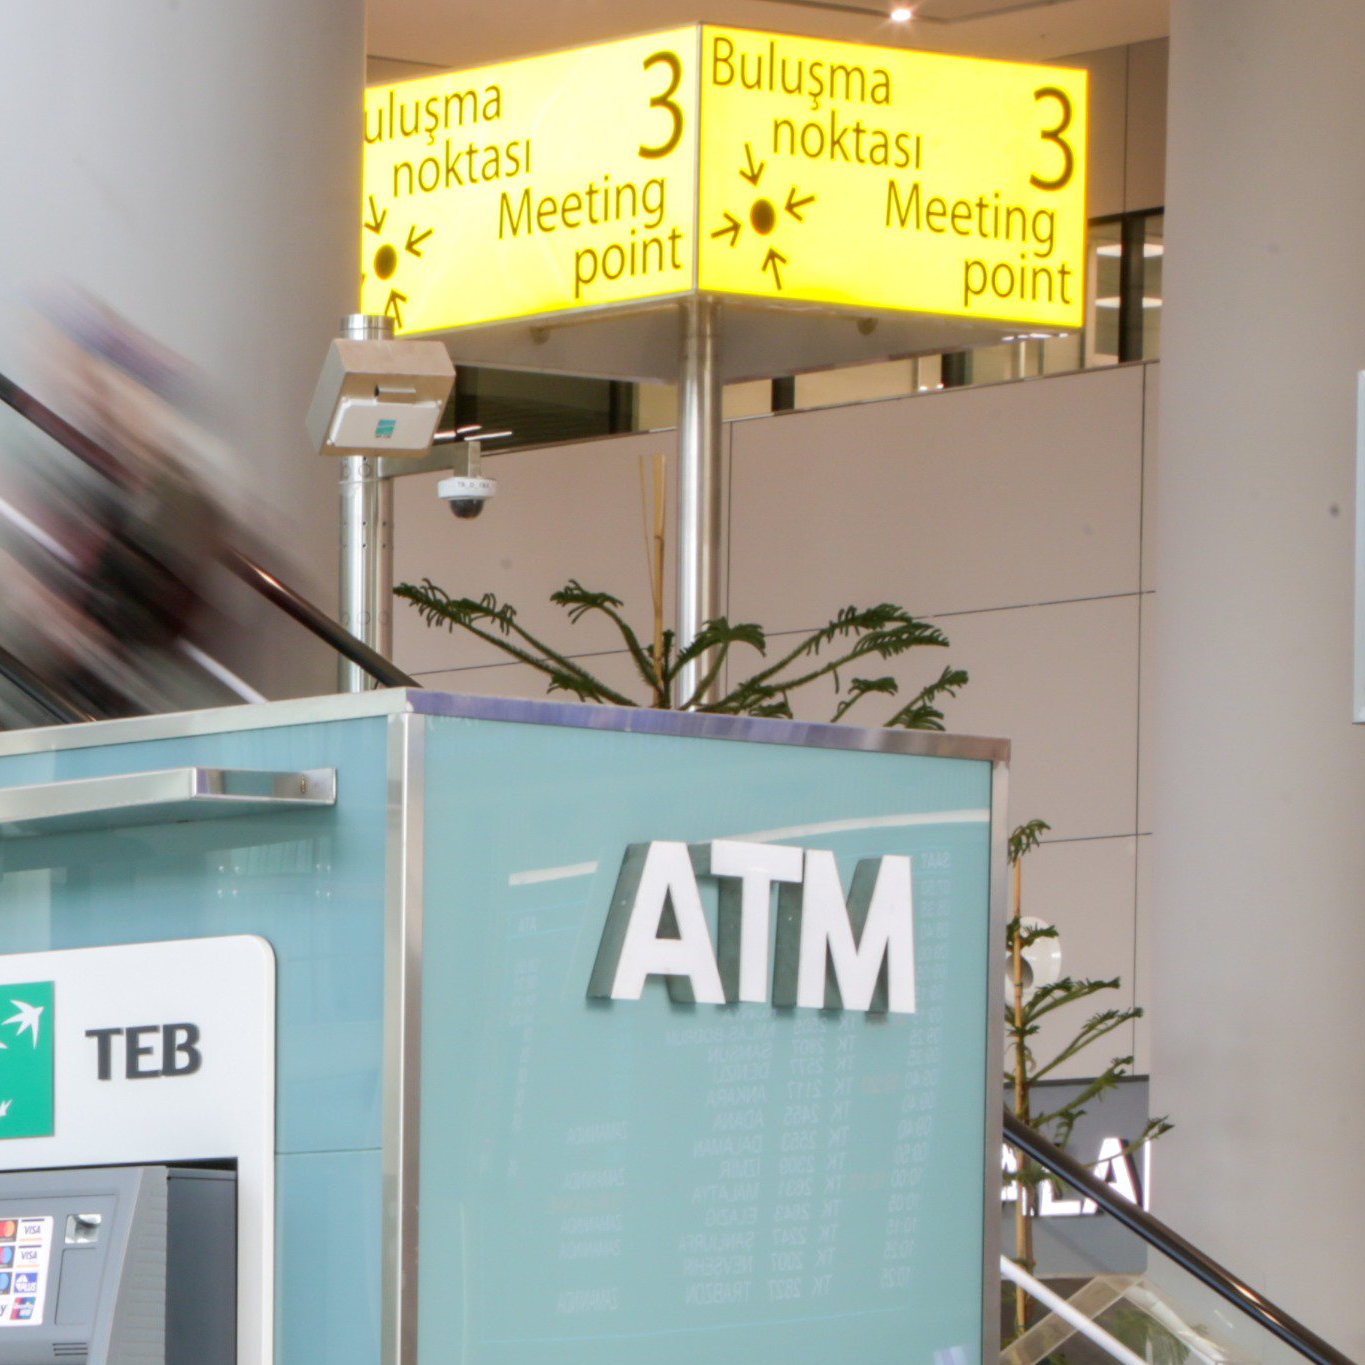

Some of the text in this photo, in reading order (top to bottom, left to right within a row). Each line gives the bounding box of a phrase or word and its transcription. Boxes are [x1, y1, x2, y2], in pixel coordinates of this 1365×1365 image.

[638, 50, 684, 160] 3
[711, 36, 893, 111] Buluşma
[364, 85, 502, 146] uluşma
[772, 110, 922, 170] noktası
[1028, 86, 1075, 191] 3
[393, 138, 531, 198] noktası
[499, 175, 666, 240] Meeting
[885, 179, 1056, 258] Meeting
[575, 227, 683, 299] point
[965, 253, 1072, 307] point
[609, 839, 916, 1014] ATM
[85, 1022, 203, 1080] TEB
